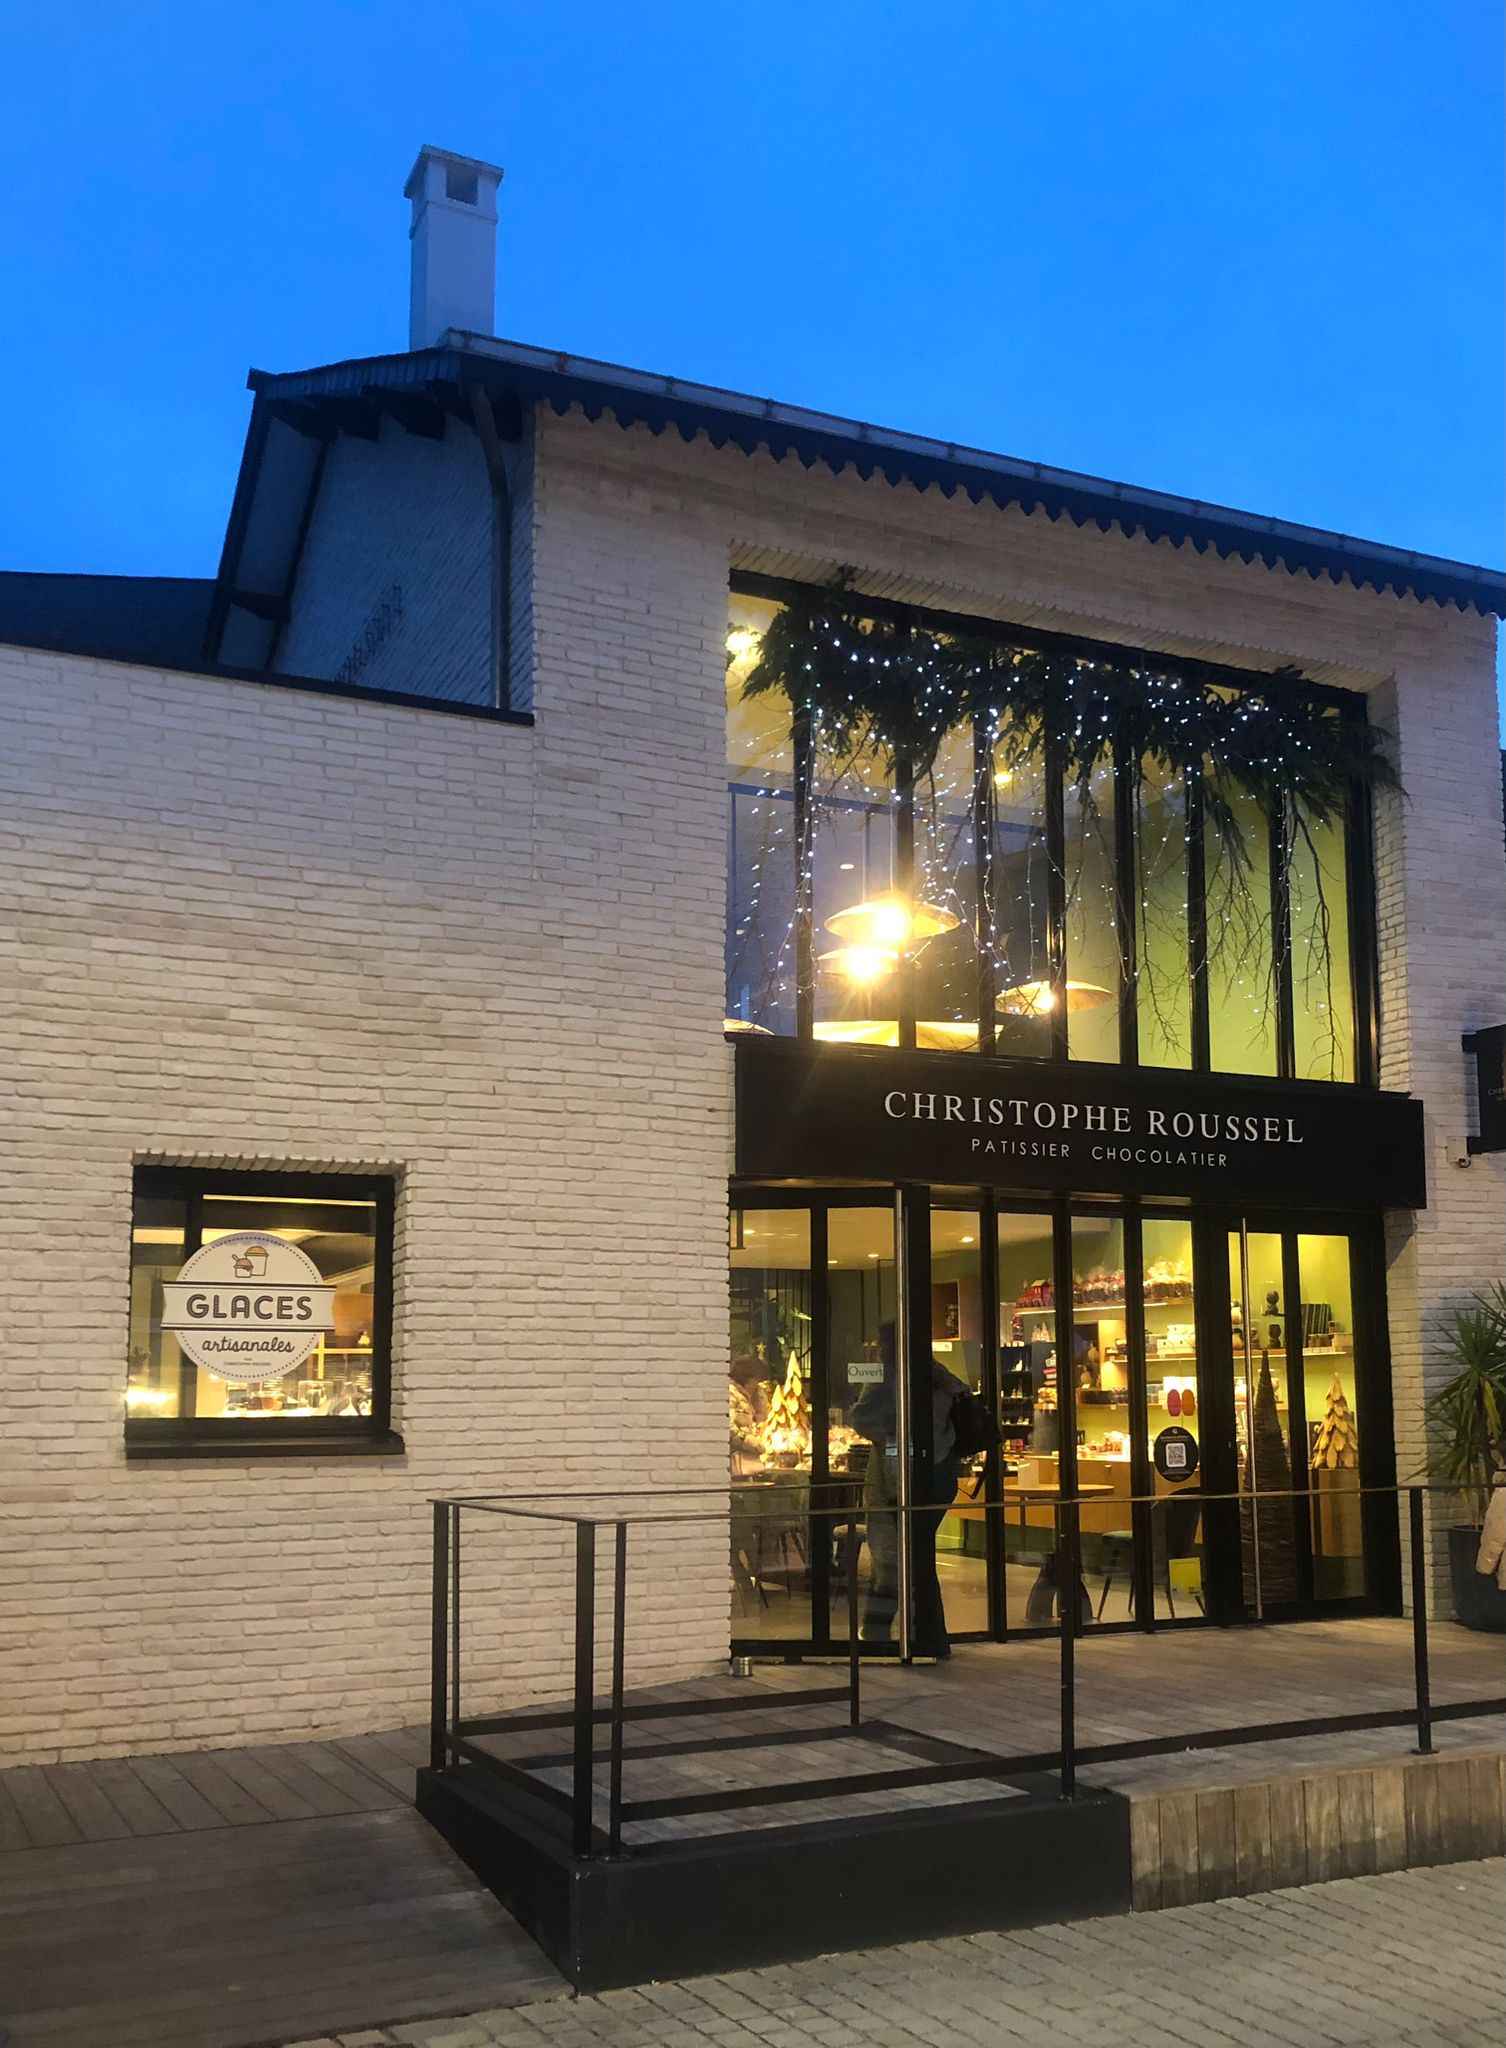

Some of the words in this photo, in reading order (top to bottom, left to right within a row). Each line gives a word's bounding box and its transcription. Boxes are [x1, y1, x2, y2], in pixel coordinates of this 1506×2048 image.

[884, 1090, 1131, 1134] CHRISTOPHE
[1147, 1111, 1304, 1144] ROUSSEL
[971, 1137, 1071, 1159] PATISSIER
[1091, 1145, 1228, 1168] CHOCOLATIER
[186, 1293, 313, 1320] GLACES
[202, 1336, 295, 1354] artisanales
[848, 1365, 883, 1377] Ouvert
